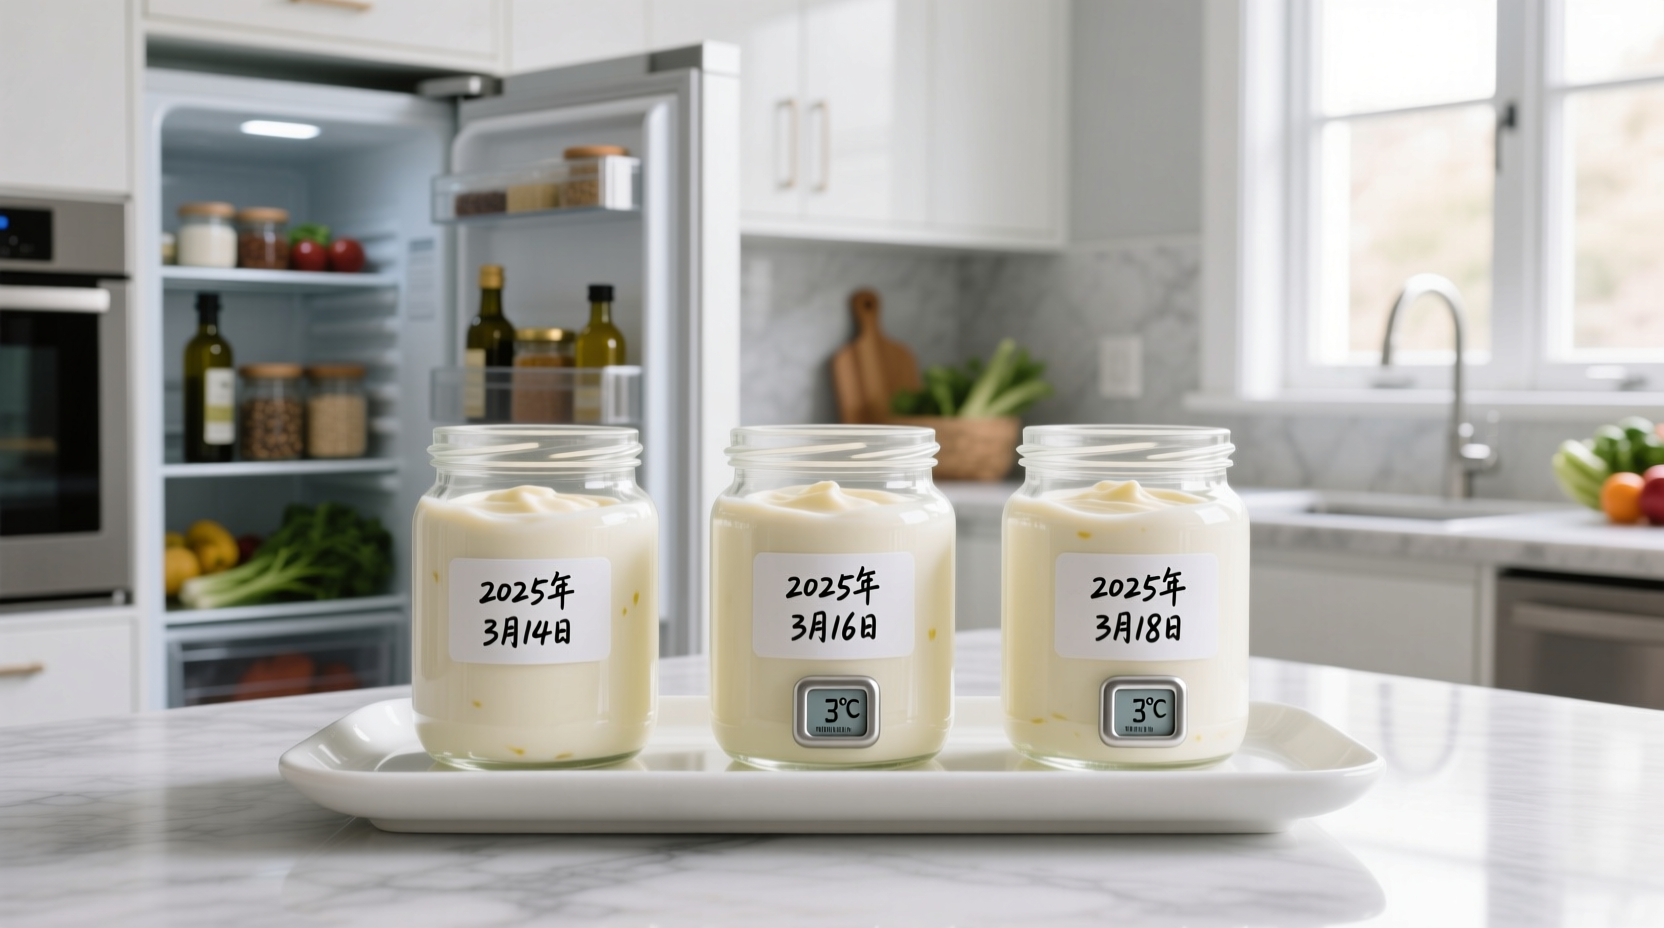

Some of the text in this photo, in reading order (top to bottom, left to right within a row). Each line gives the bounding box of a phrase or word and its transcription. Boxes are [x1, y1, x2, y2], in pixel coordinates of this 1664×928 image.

[479, 571, 574, 610] 2025年
[786, 566, 879, 605] 2025年
[1091, 567, 1186, 606] 2025年
[483, 616, 571, 648] 3月14日
[791, 611, 877, 643] 3月16日
[1095, 612, 1181, 644] 3月18日
[825, 697, 860, 723] 3°C
[1132, 697, 1167, 723] 3°C
